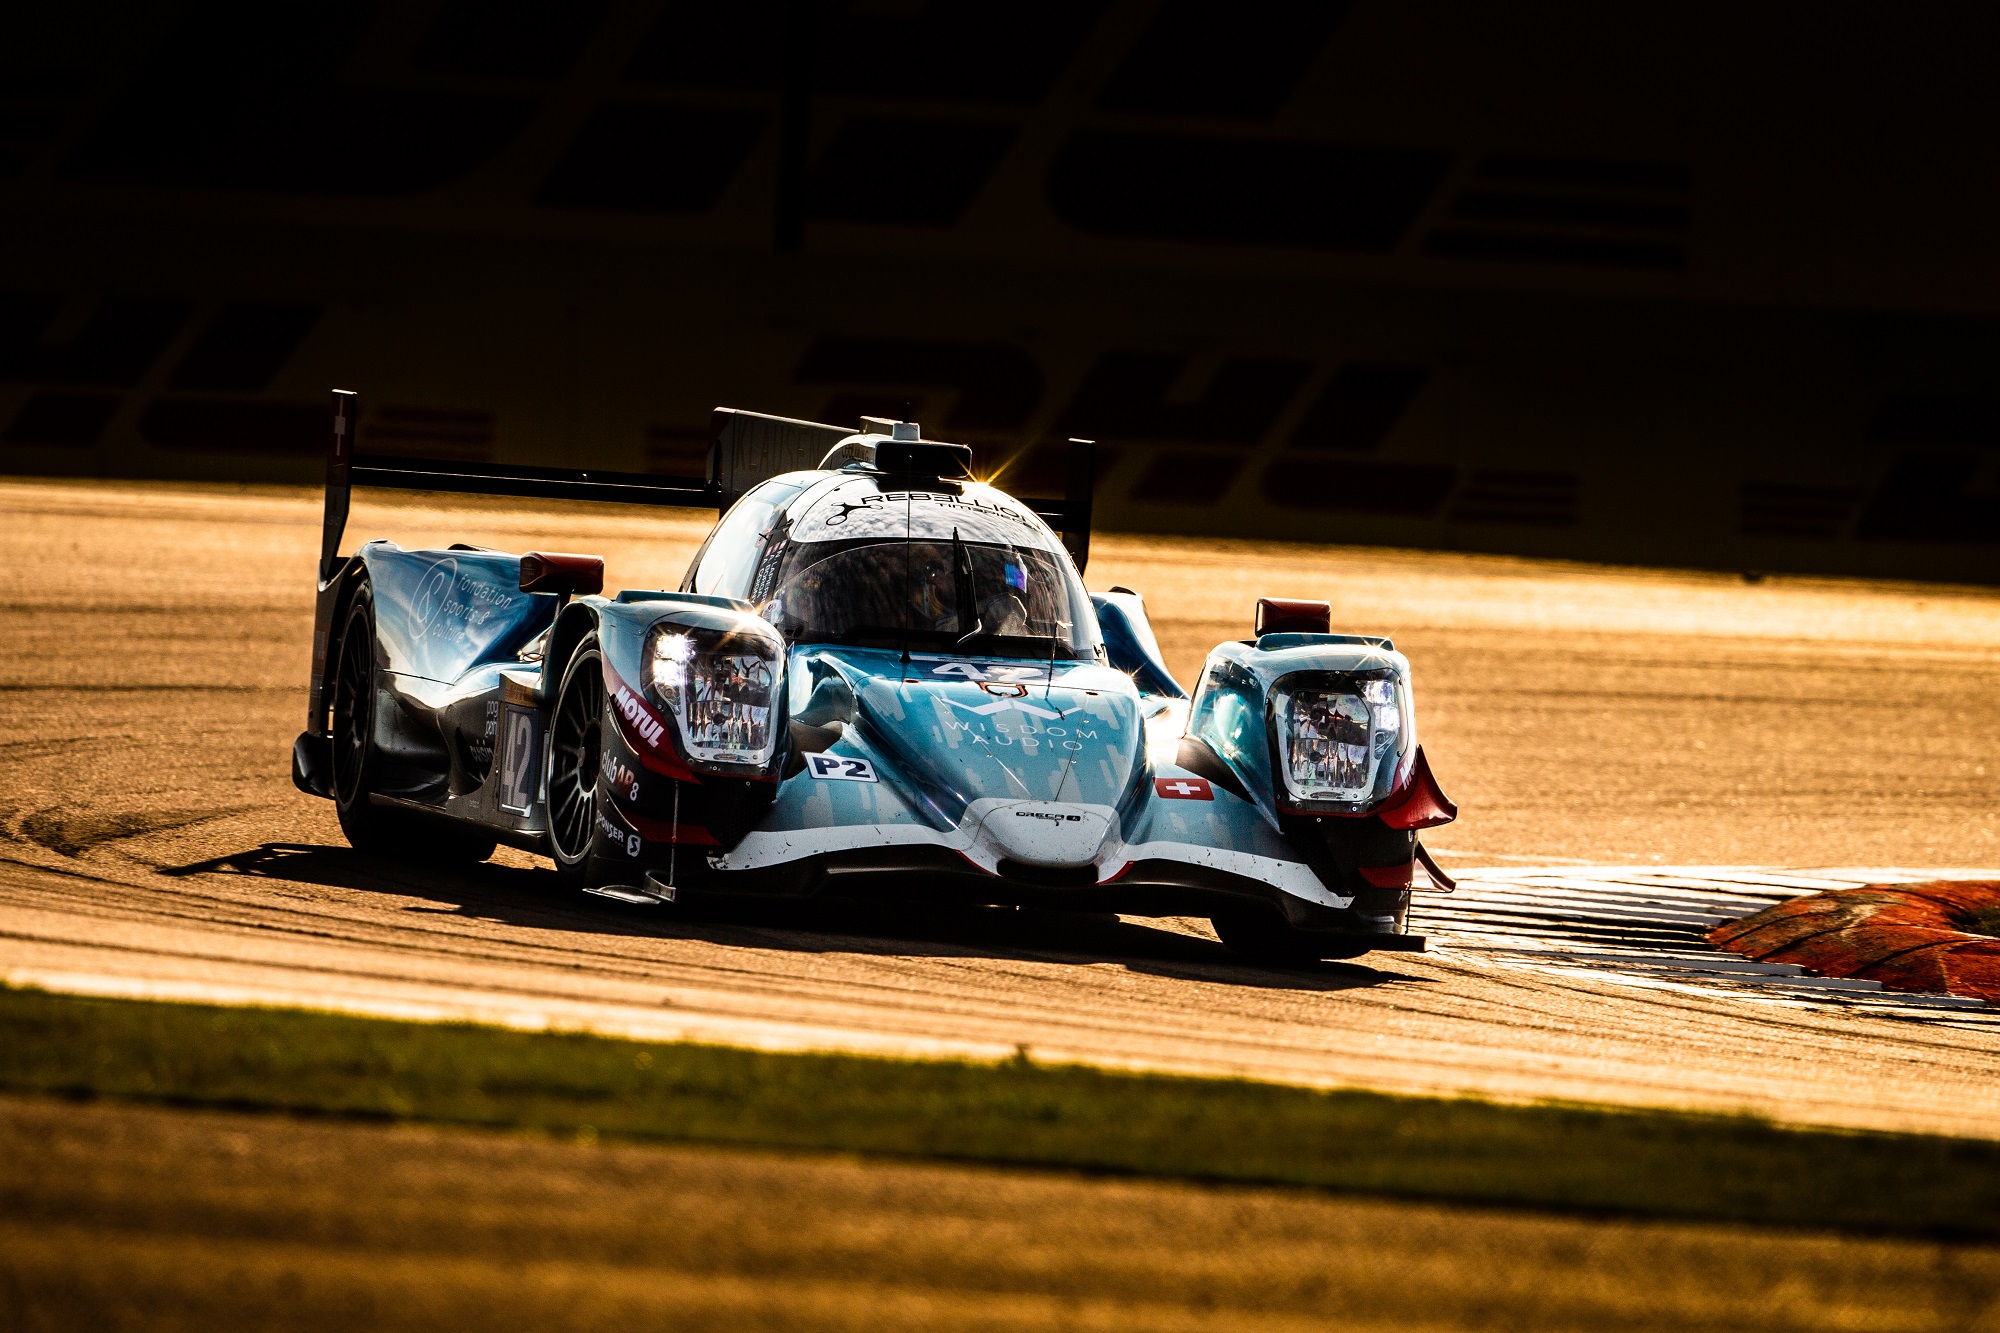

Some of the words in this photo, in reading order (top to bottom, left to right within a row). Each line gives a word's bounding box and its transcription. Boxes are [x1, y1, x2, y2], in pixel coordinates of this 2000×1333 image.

[456, 573, 512, 609] fondation
[443, 598, 478, 622] sports
[432, 621, 465, 642] culture
[932, 662, 1045, 682] 42
[614, 685, 665, 748] MOTUL
[944, 719, 1099, 741] WISDOM
[971, 735, 1084, 751] AUDIO
[504, 712, 532, 809] 42
[814, 758, 872, 779] P2
